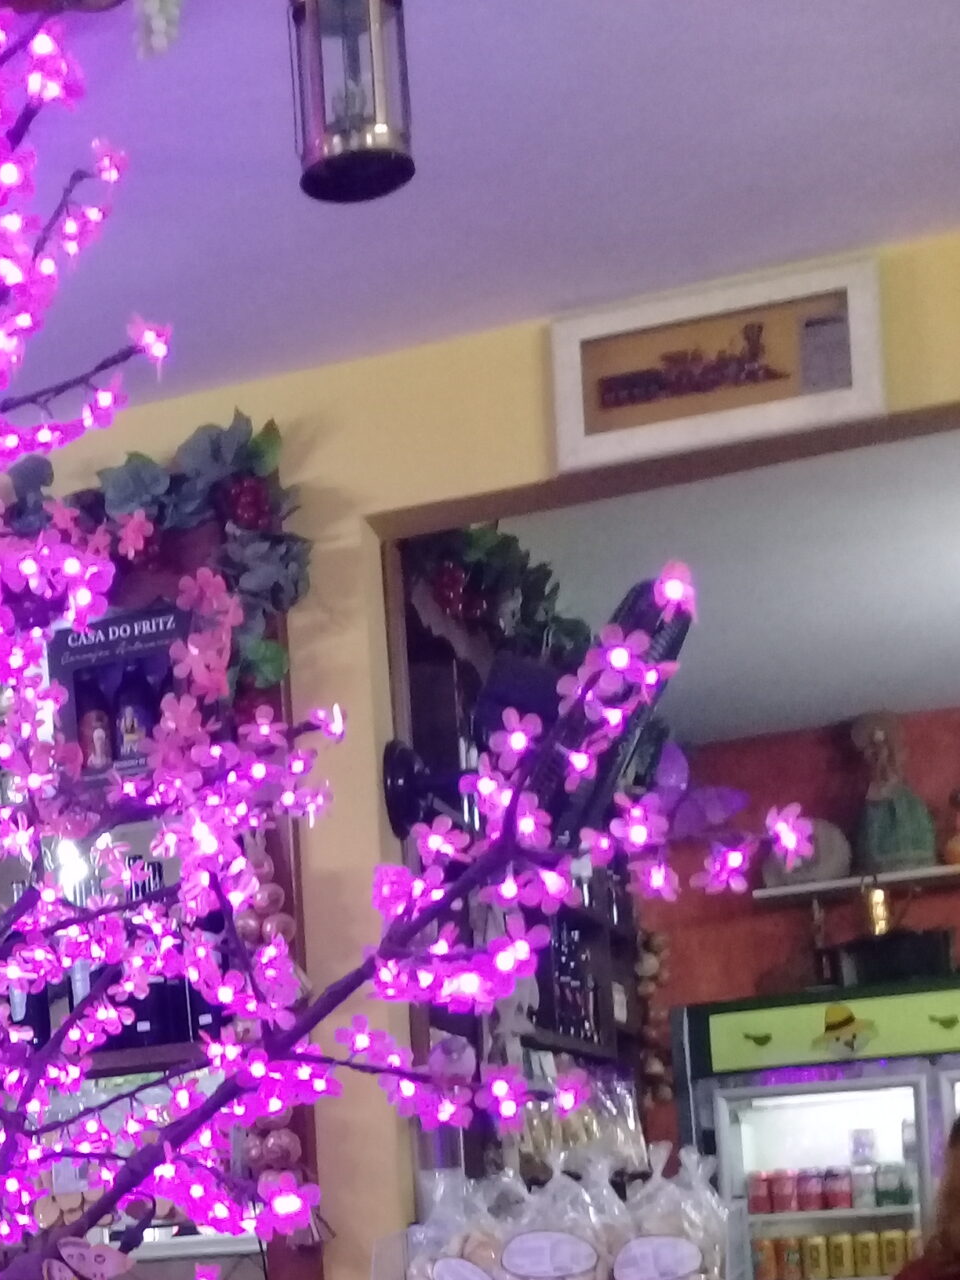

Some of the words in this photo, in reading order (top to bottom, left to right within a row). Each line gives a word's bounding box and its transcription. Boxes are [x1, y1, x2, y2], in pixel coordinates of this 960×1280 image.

[68, 629, 105, 648] CASA
[108, 623, 131, 641] DO
[134, 615, 176, 636] FRITZ
